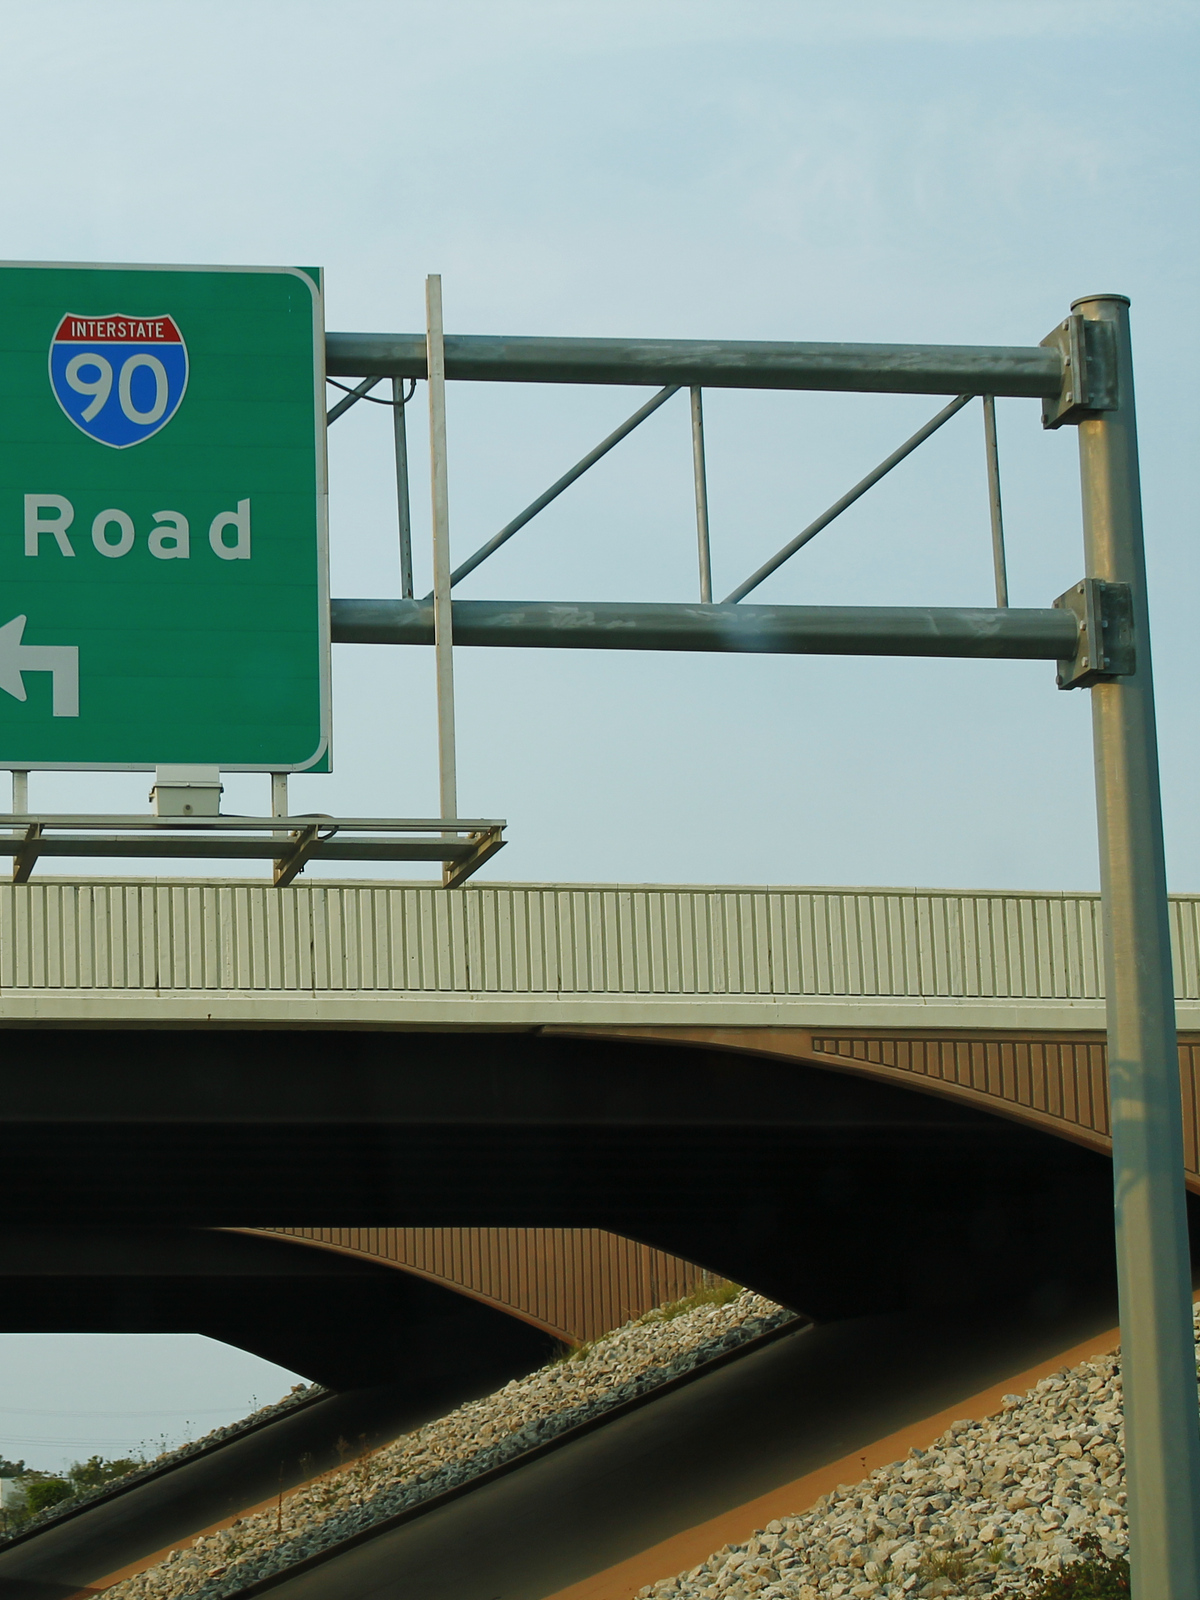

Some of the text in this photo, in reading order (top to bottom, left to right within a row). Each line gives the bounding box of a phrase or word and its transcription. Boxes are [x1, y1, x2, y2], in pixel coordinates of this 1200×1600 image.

[71, 320, 165, 339] INTERSTATE
[65, 352, 169, 425] 90
[24, 493, 251, 559] Road
